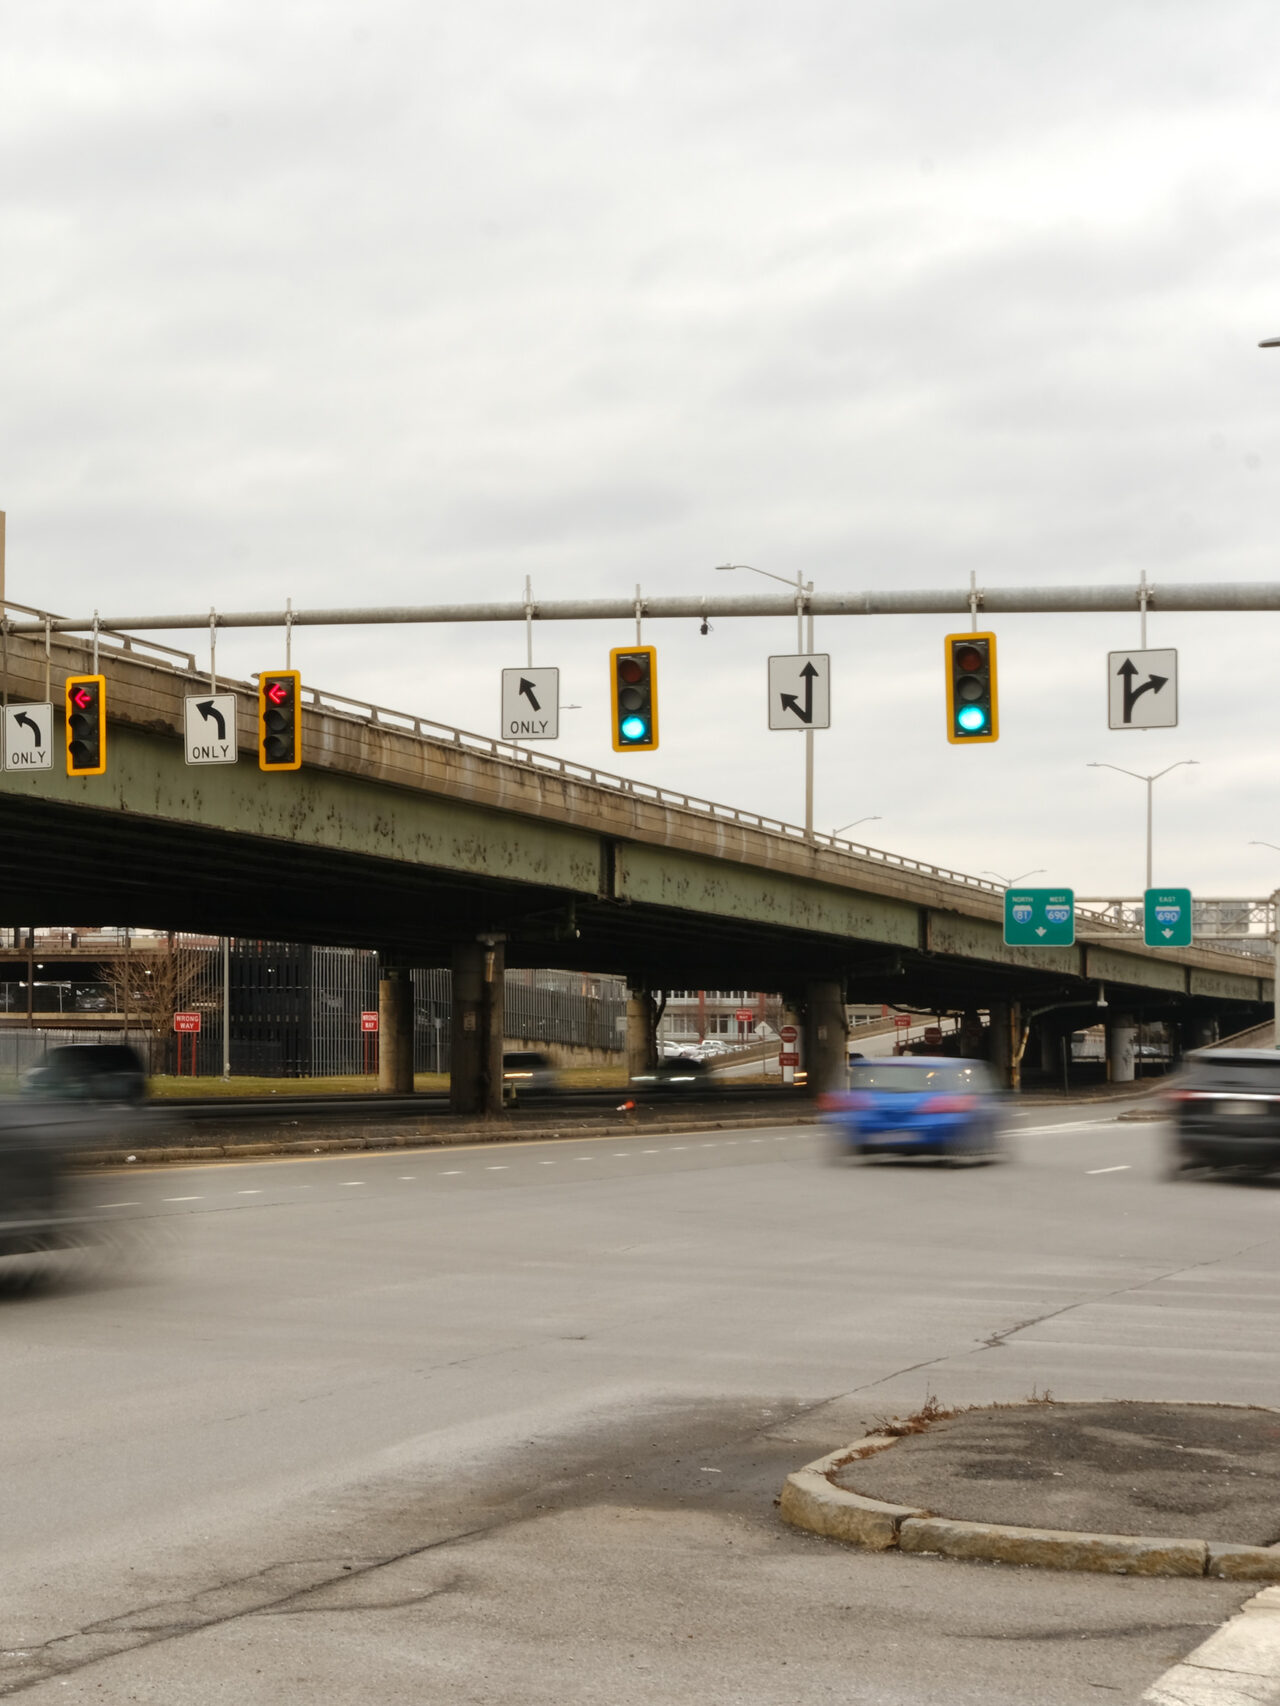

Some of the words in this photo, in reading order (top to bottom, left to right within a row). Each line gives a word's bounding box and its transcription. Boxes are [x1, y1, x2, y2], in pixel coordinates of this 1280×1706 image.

[510, 720, 549, 735] ONLY
[11, 750, 47, 766] ONLY
[192, 744, 230, 760] ONLY
[1016, 911, 1028, 920] 81
[1048, 911, 1067, 921] 690
[1157, 911, 1177, 922] 690
